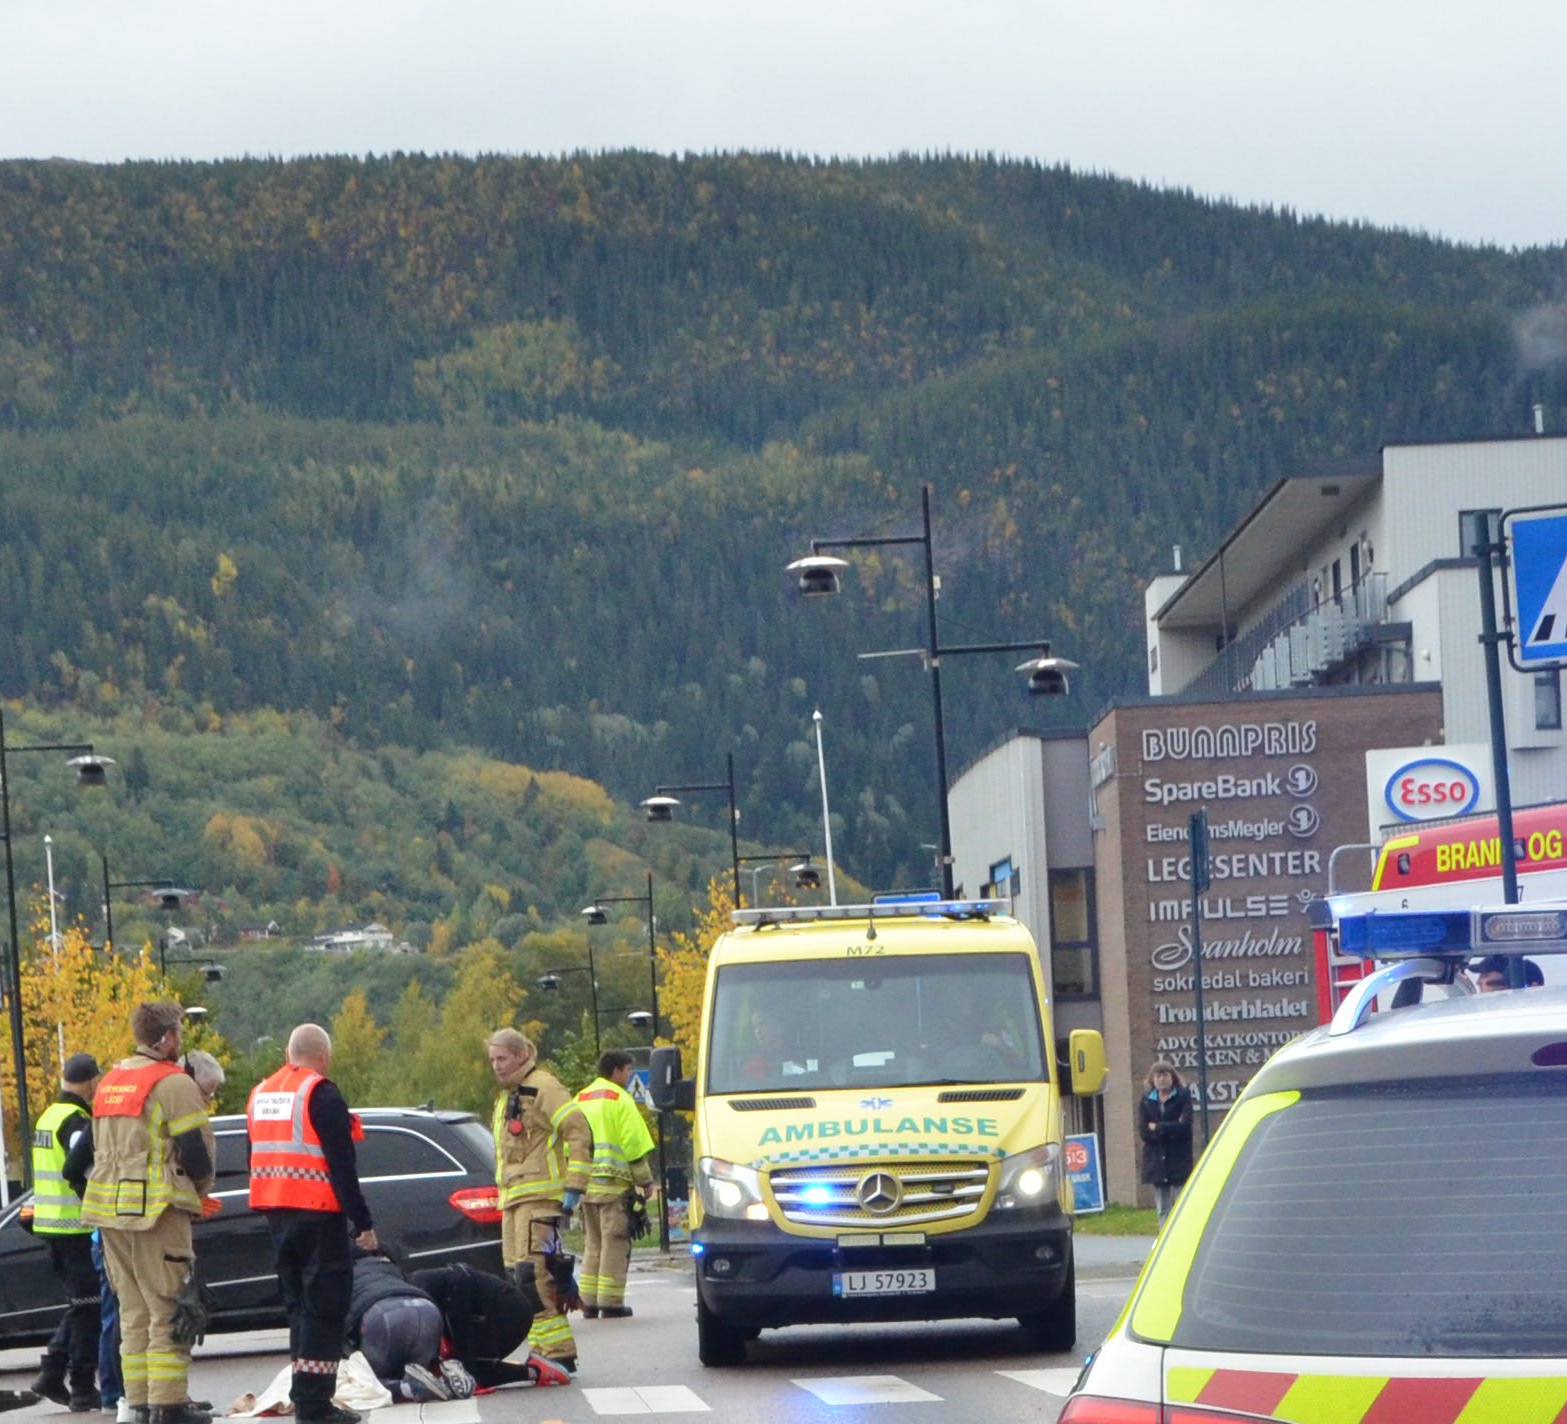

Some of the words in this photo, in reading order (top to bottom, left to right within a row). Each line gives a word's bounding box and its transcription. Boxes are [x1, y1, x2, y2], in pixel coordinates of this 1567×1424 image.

[1142, 720, 1317, 761] BUNNPRIS
[1144, 771, 1282, 806] SpareBank
[1400, 777, 1467, 806] Esso
[1436, 839, 1504, 873] BRAN
[1528, 831, 1563, 862] OG
[1248, 966, 1309, 987] bakeri
[757, 1117, 1000, 1147] AMBULANSE
[848, 1275, 866, 1291] LJ
[875, 1271, 928, 1290] 57923
